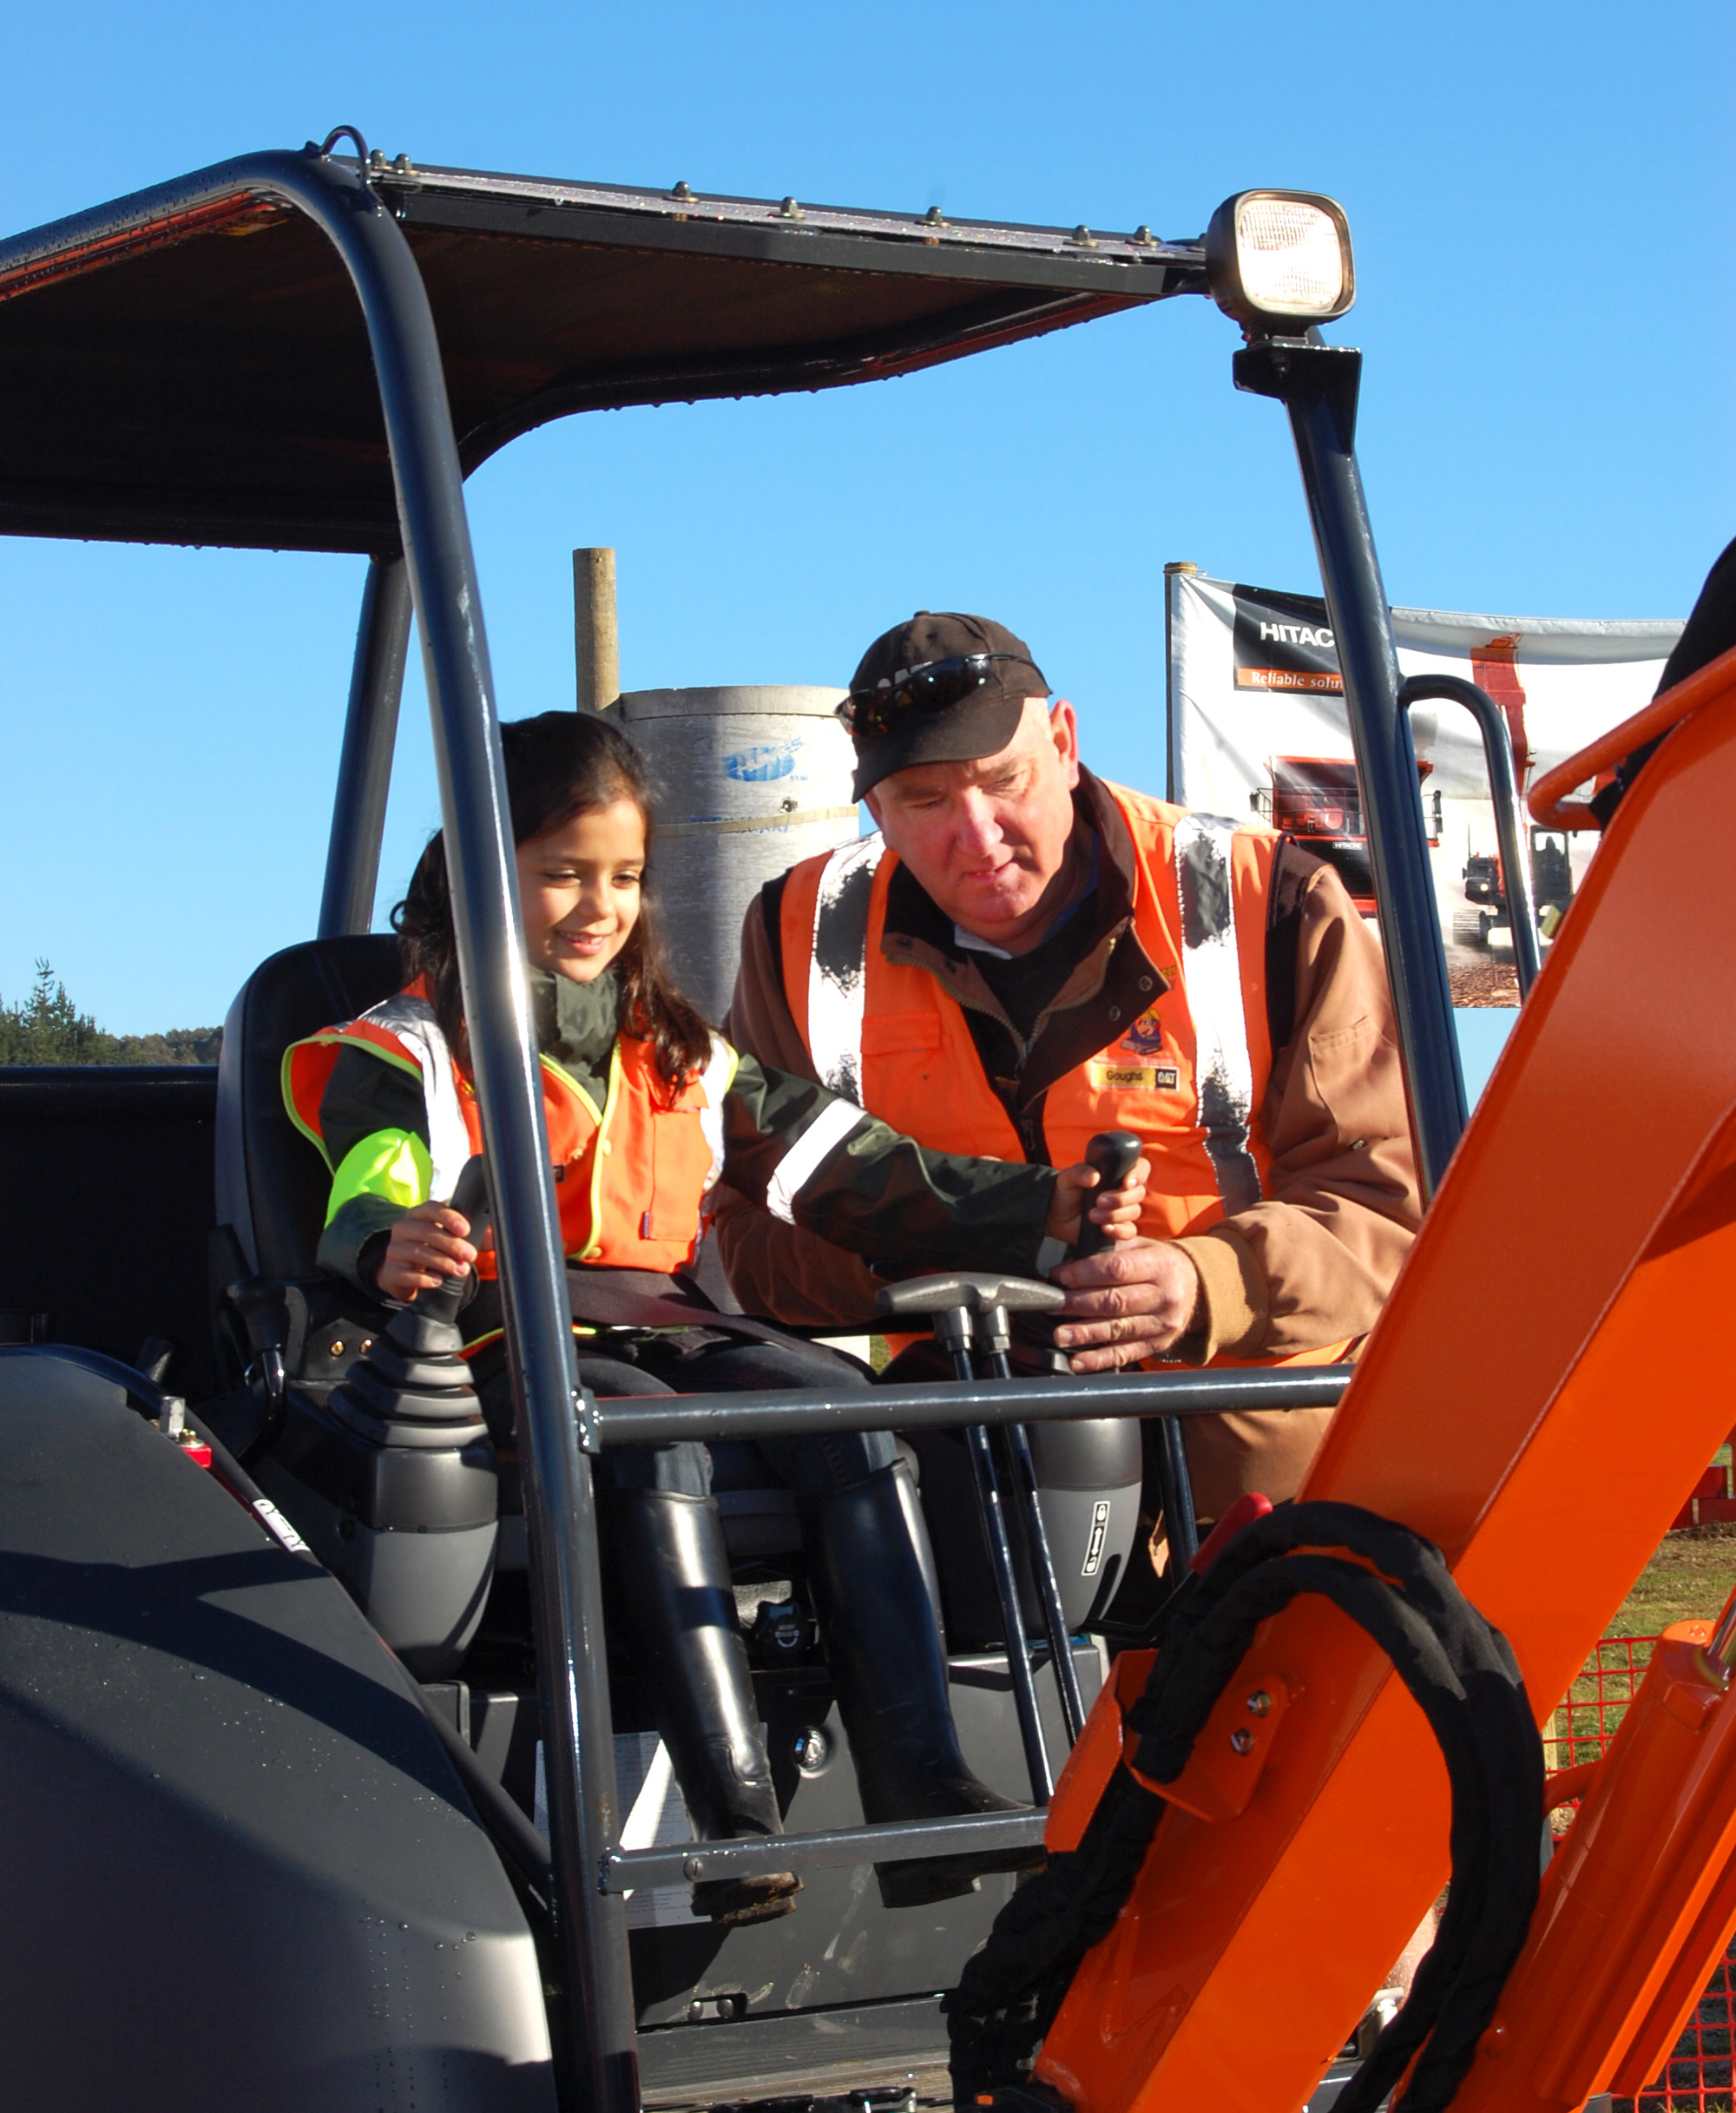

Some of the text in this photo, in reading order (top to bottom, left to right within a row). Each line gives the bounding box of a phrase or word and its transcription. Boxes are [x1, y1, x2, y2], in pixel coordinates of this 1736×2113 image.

[1252, 672, 1305, 686] Reliable
[1106, 1070, 1175, 1084] Goughs CAT
